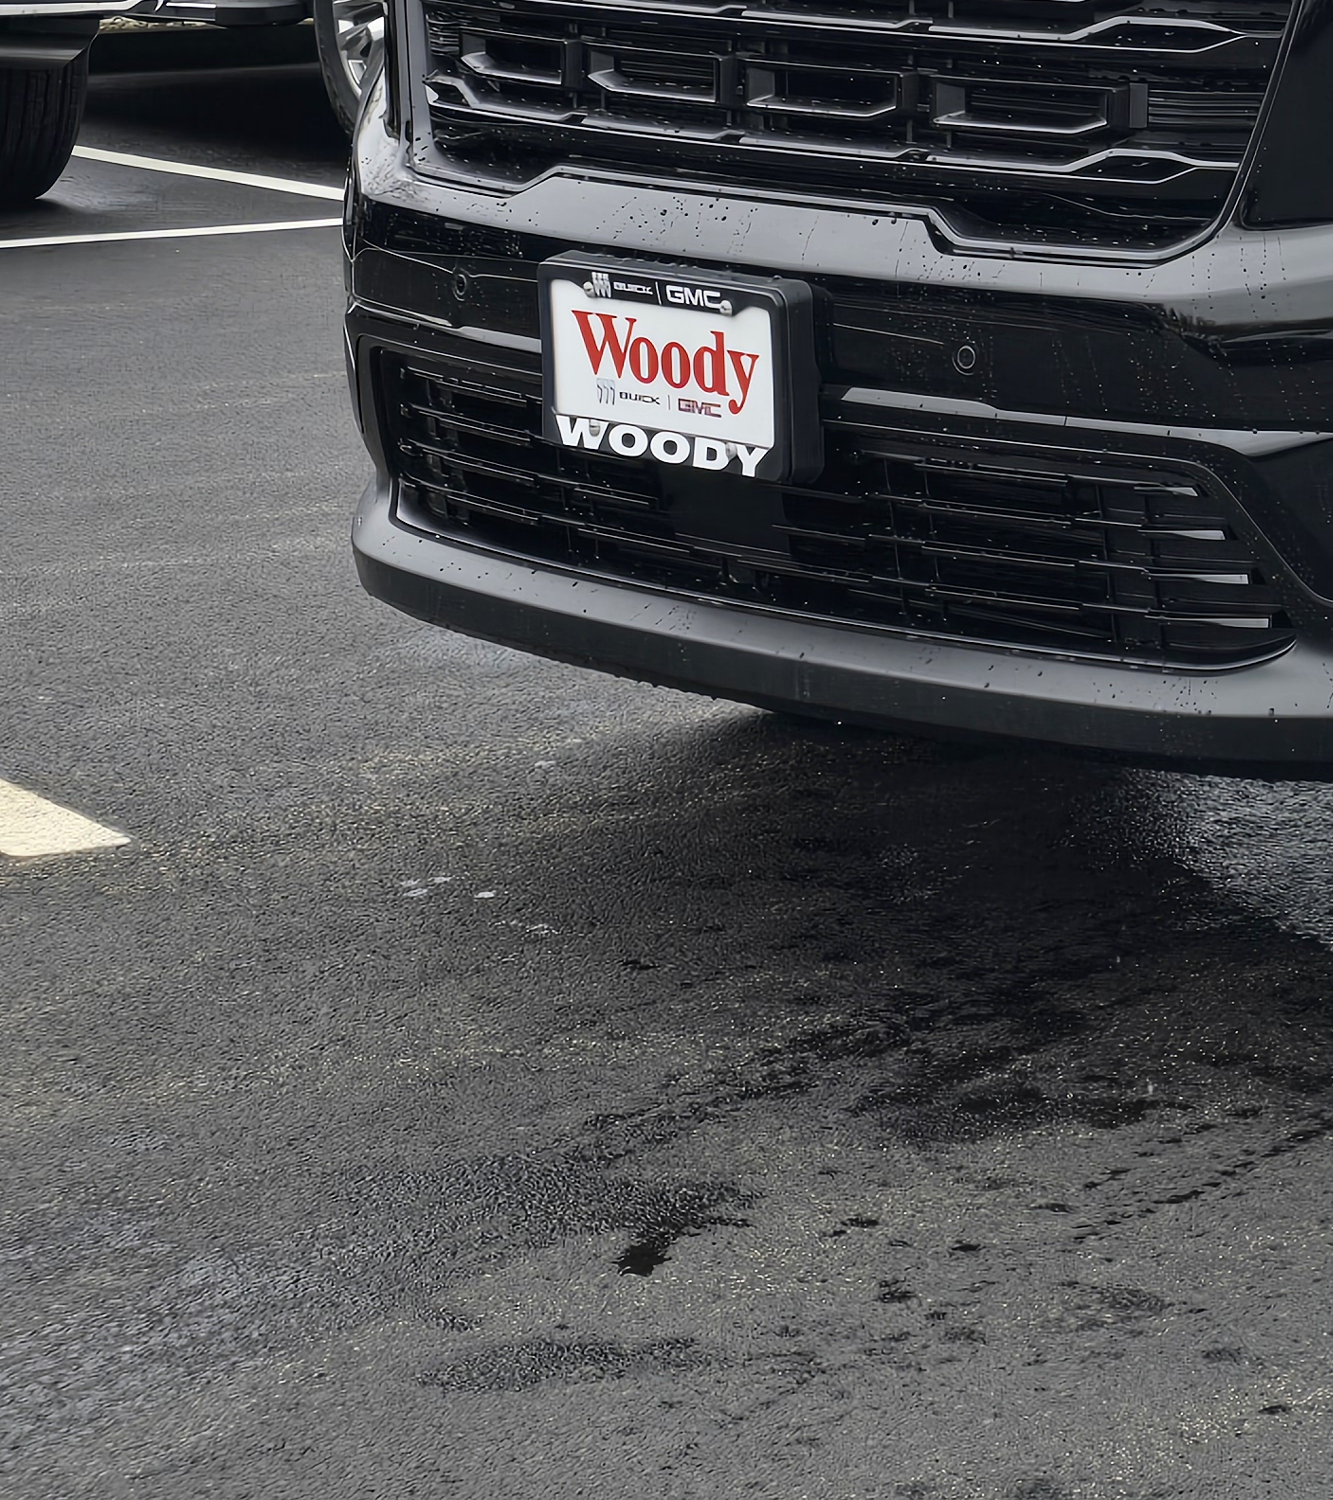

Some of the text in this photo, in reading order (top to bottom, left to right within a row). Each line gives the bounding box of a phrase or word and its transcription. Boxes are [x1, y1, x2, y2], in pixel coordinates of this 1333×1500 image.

[613, 282, 722, 310] BUICK GMC
[570, 309, 760, 415] Woody
[619, 391, 722, 418] BUICK GMC
[555, 414, 769, 478] WOODY
